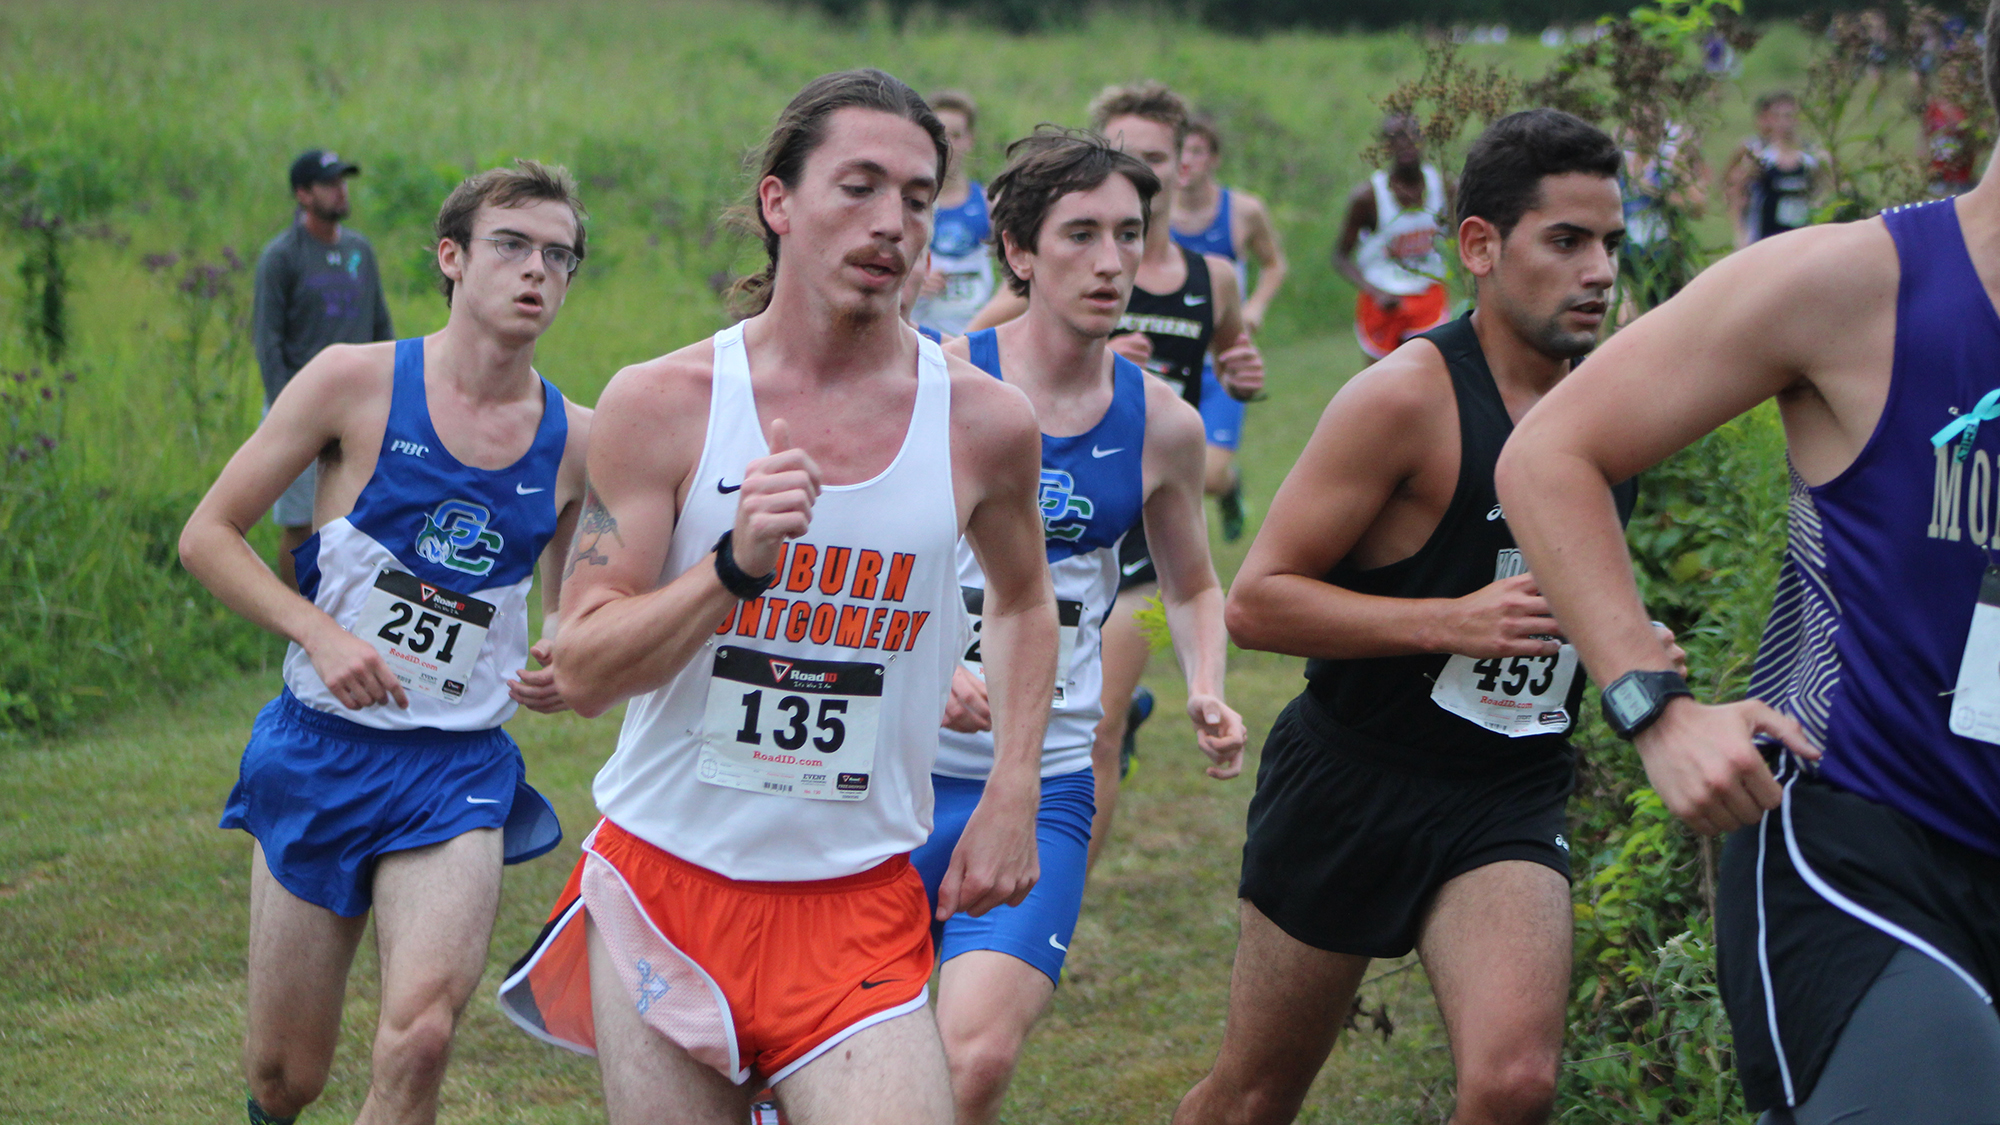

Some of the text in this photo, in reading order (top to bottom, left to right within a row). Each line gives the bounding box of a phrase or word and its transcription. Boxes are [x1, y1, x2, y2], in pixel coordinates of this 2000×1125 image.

[1114, 313, 1202, 338] OUTHERN
[391, 439, 429, 459] PBC
[1927, 443, 2000, 550] MO
[767, 542, 916, 602] BURN
[377, 602, 462, 664] 251
[715, 597, 931, 652] NTGOMERY
[389, 647, 438, 671] RoadID.com
[790, 670, 838, 683] RoadID
[1473, 651, 1559, 696] 453
[1480, 695, 1533, 709] RoadID.com
[736, 689, 848, 754] 135
[752, 750, 823, 767] RoadID.com
[803, 773, 826, 781] EVENT
